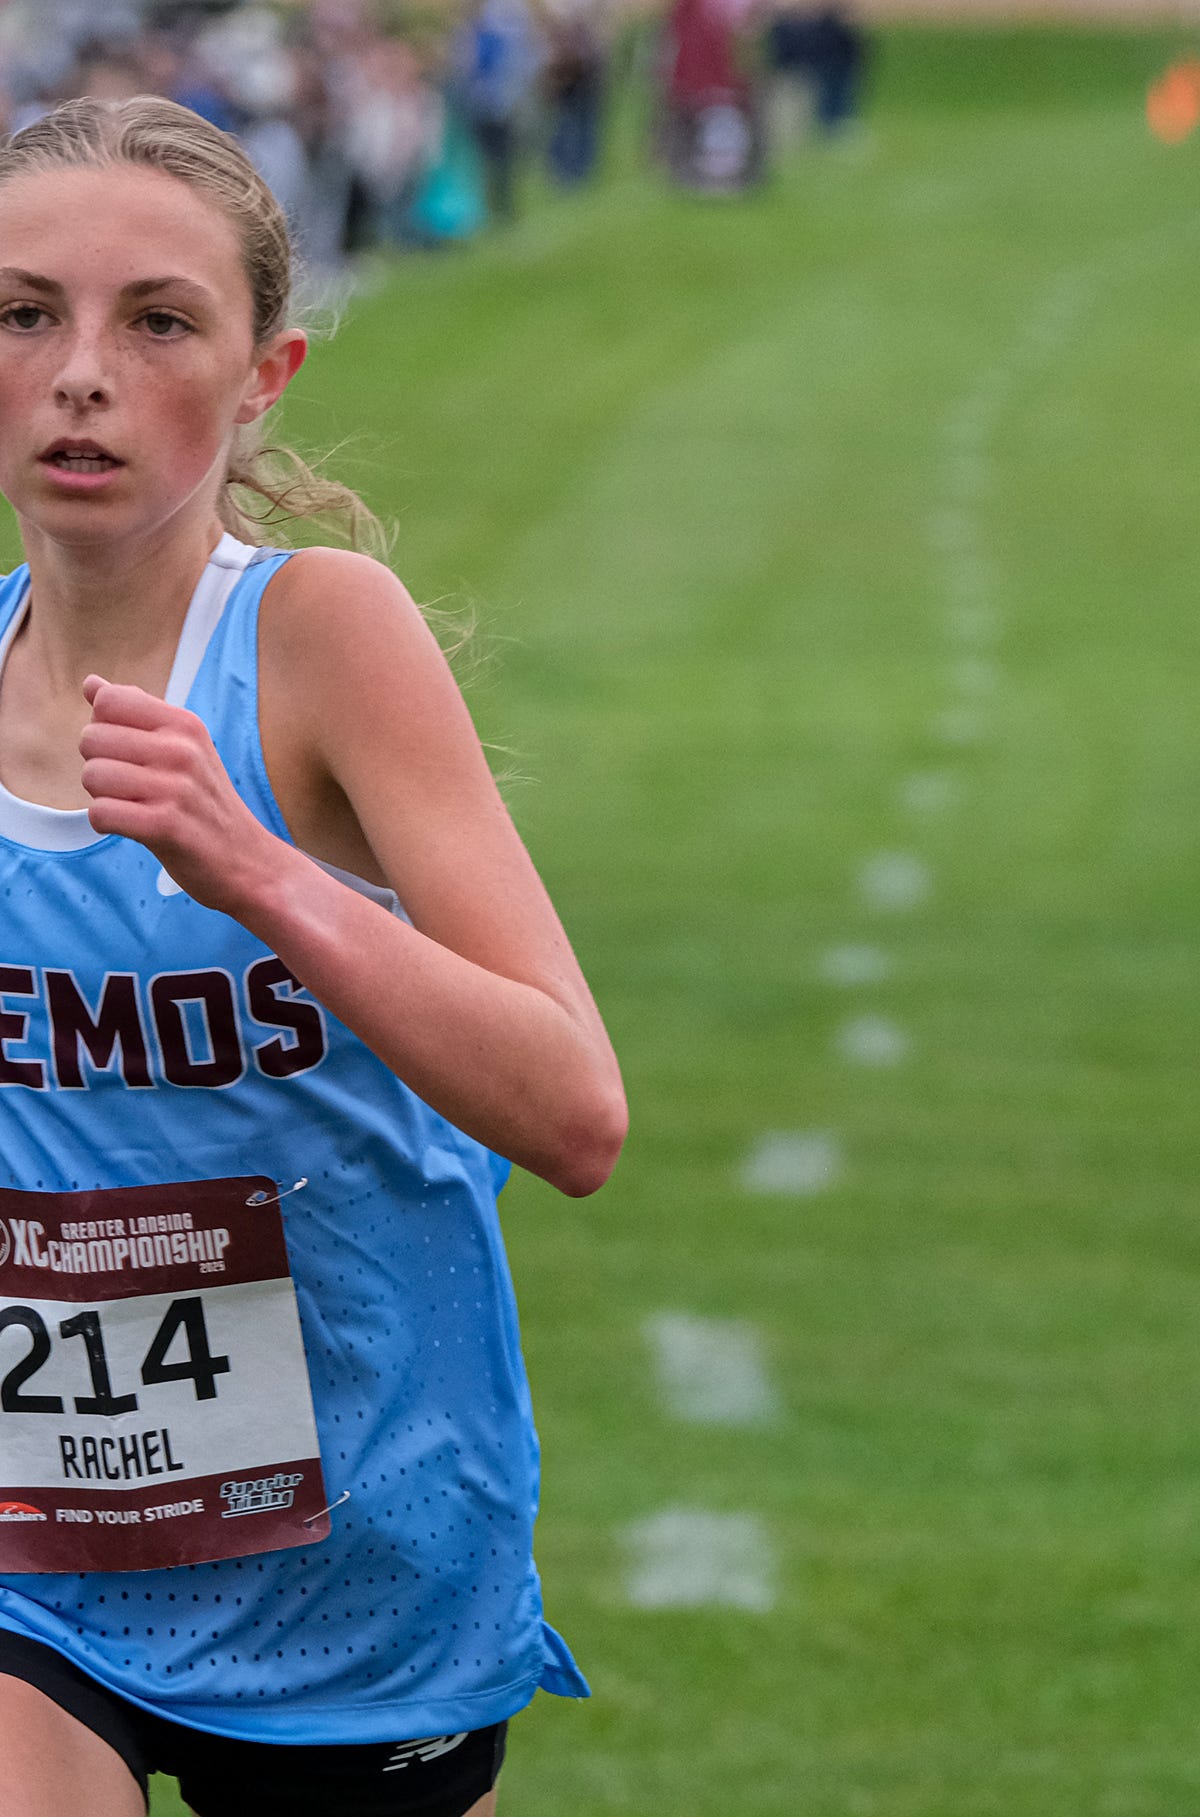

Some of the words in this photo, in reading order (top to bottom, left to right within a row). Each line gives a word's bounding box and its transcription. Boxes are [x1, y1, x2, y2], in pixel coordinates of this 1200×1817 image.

[60, 1219, 126, 1240] GREATER
[128, 1213, 194, 1235] LANSING
[8, 1218, 49, 1267] XC
[47, 1228, 231, 1273] CHAMPIONSHIP
[59, 1428, 183, 1480] RACHEL
[219, 1473, 304, 1498] Superior
[55, 1509, 94, 1523] FIND
[94, 1510, 141, 1524] YOUR
[143, 1498, 205, 1522] STRIDE
[221, 1490, 294, 1518] Timing
